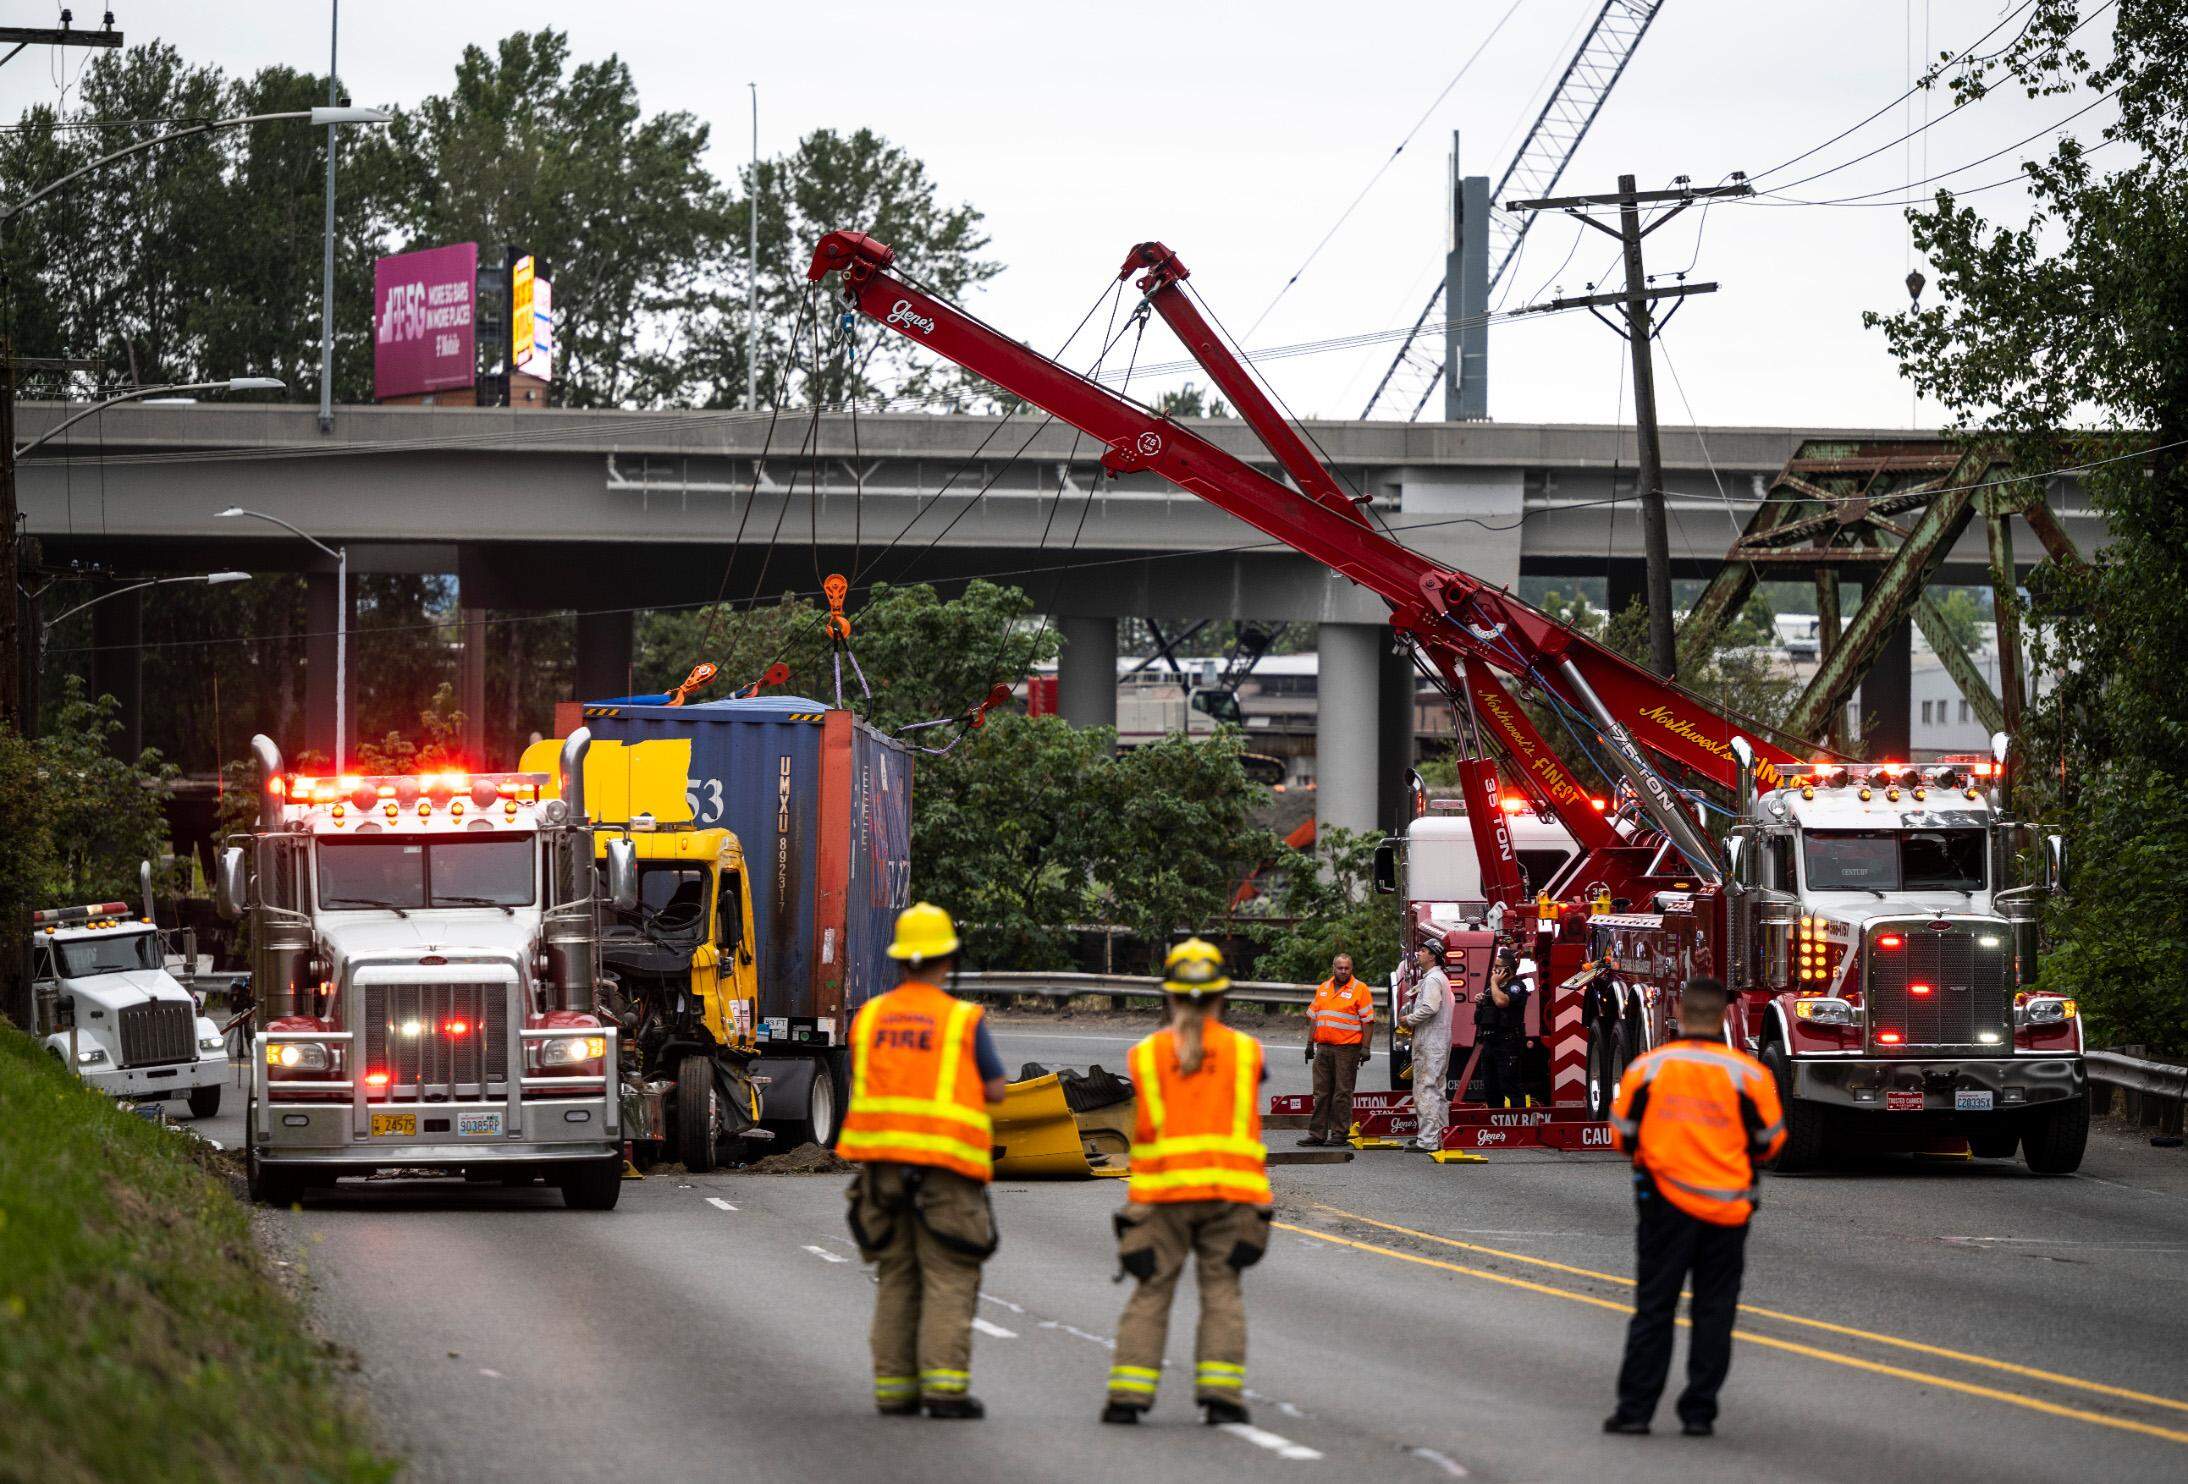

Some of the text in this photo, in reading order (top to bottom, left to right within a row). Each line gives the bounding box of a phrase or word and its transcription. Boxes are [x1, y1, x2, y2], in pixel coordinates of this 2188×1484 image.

[406, 281, 426, 340] 5G
[886, 299, 935, 335] Gene's
[1145, 436, 1157, 446] 75
[1477, 689, 1536, 758] Northwest's
[1531, 757, 1580, 805] FINEST
[686, 778, 725, 823] 53
[778, 756, 791, 833] UMXU
[1484, 778, 1512, 861] 35 TON
[874, 1029, 932, 1051] FIRE
[1353, 1096, 1388, 1108] UTION
[1477, 1129, 1506, 1147] Gene's
[1490, 1114, 1520, 1127] STAY
